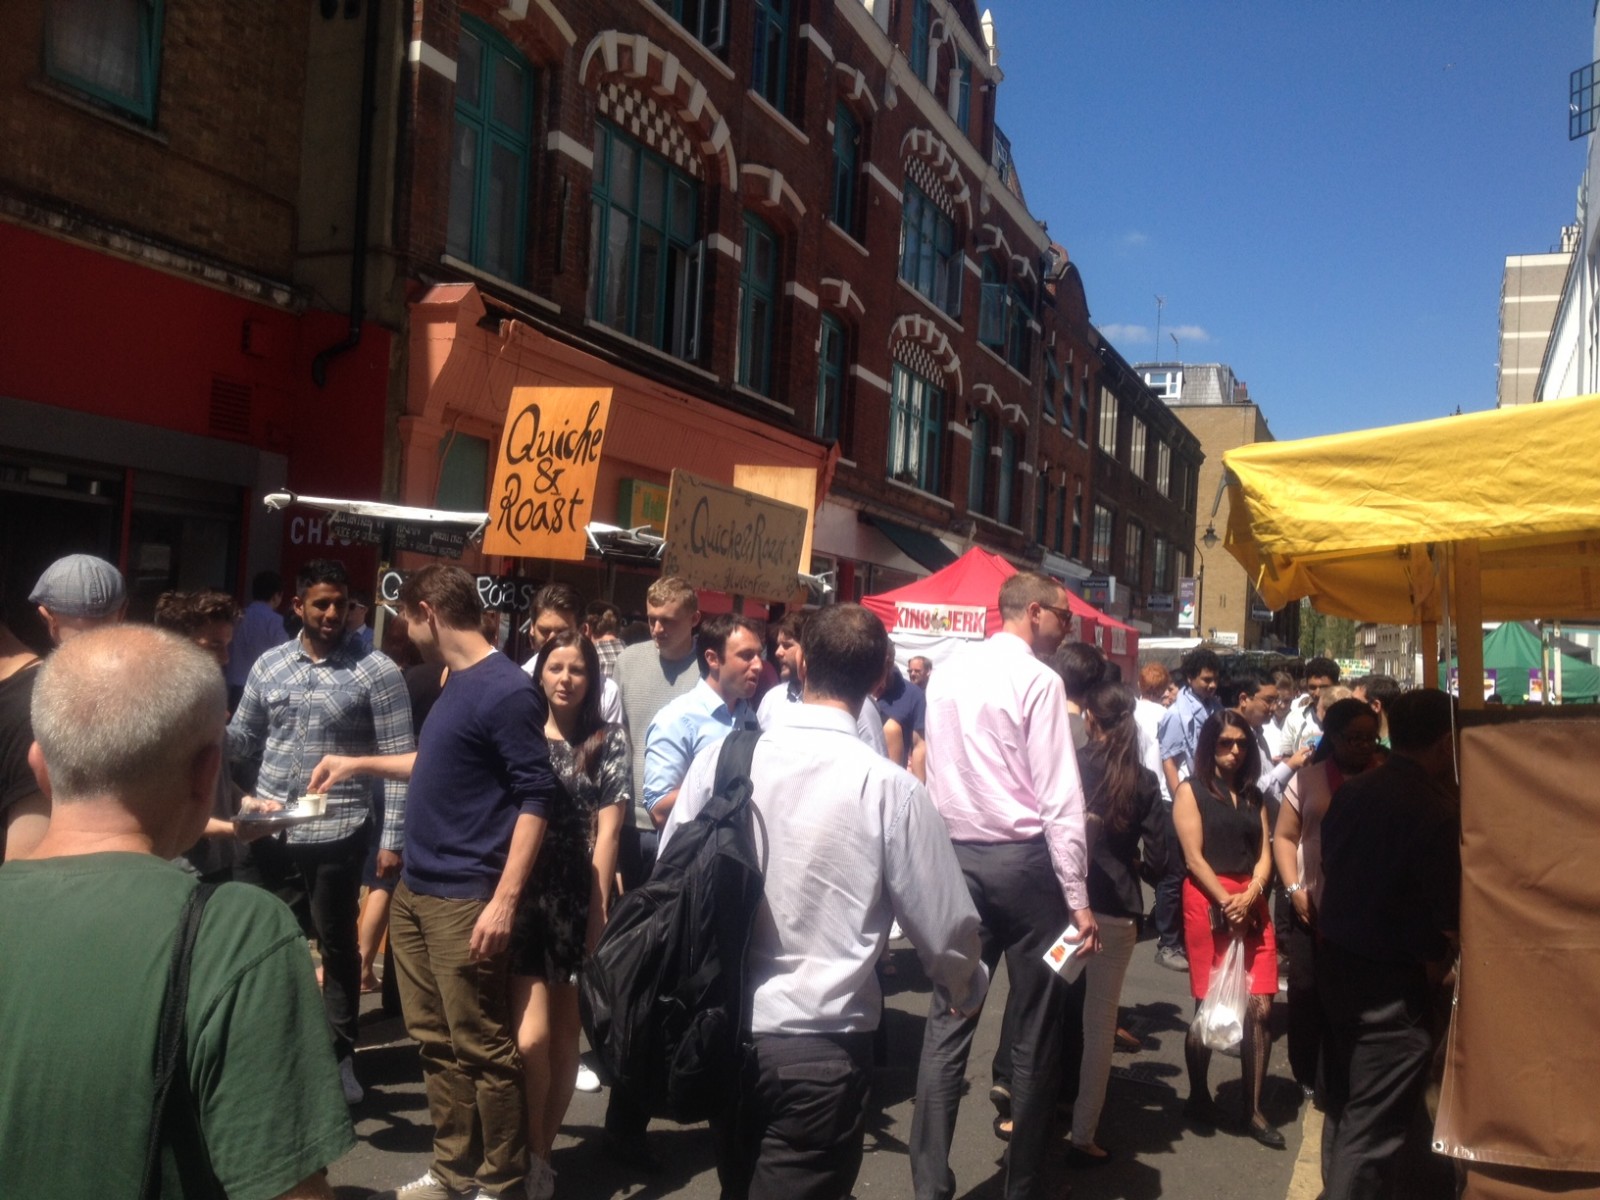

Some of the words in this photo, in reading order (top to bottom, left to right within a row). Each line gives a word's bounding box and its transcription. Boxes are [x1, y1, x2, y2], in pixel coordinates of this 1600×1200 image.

[506, 400, 603, 466] Quiche
[534, 457, 565, 495] &
[497, 472, 584, 545] Roast
[690, 496, 742, 560] Quiche
[896, 606, 931, 630] KING
[944, 610, 985, 633] JERK
